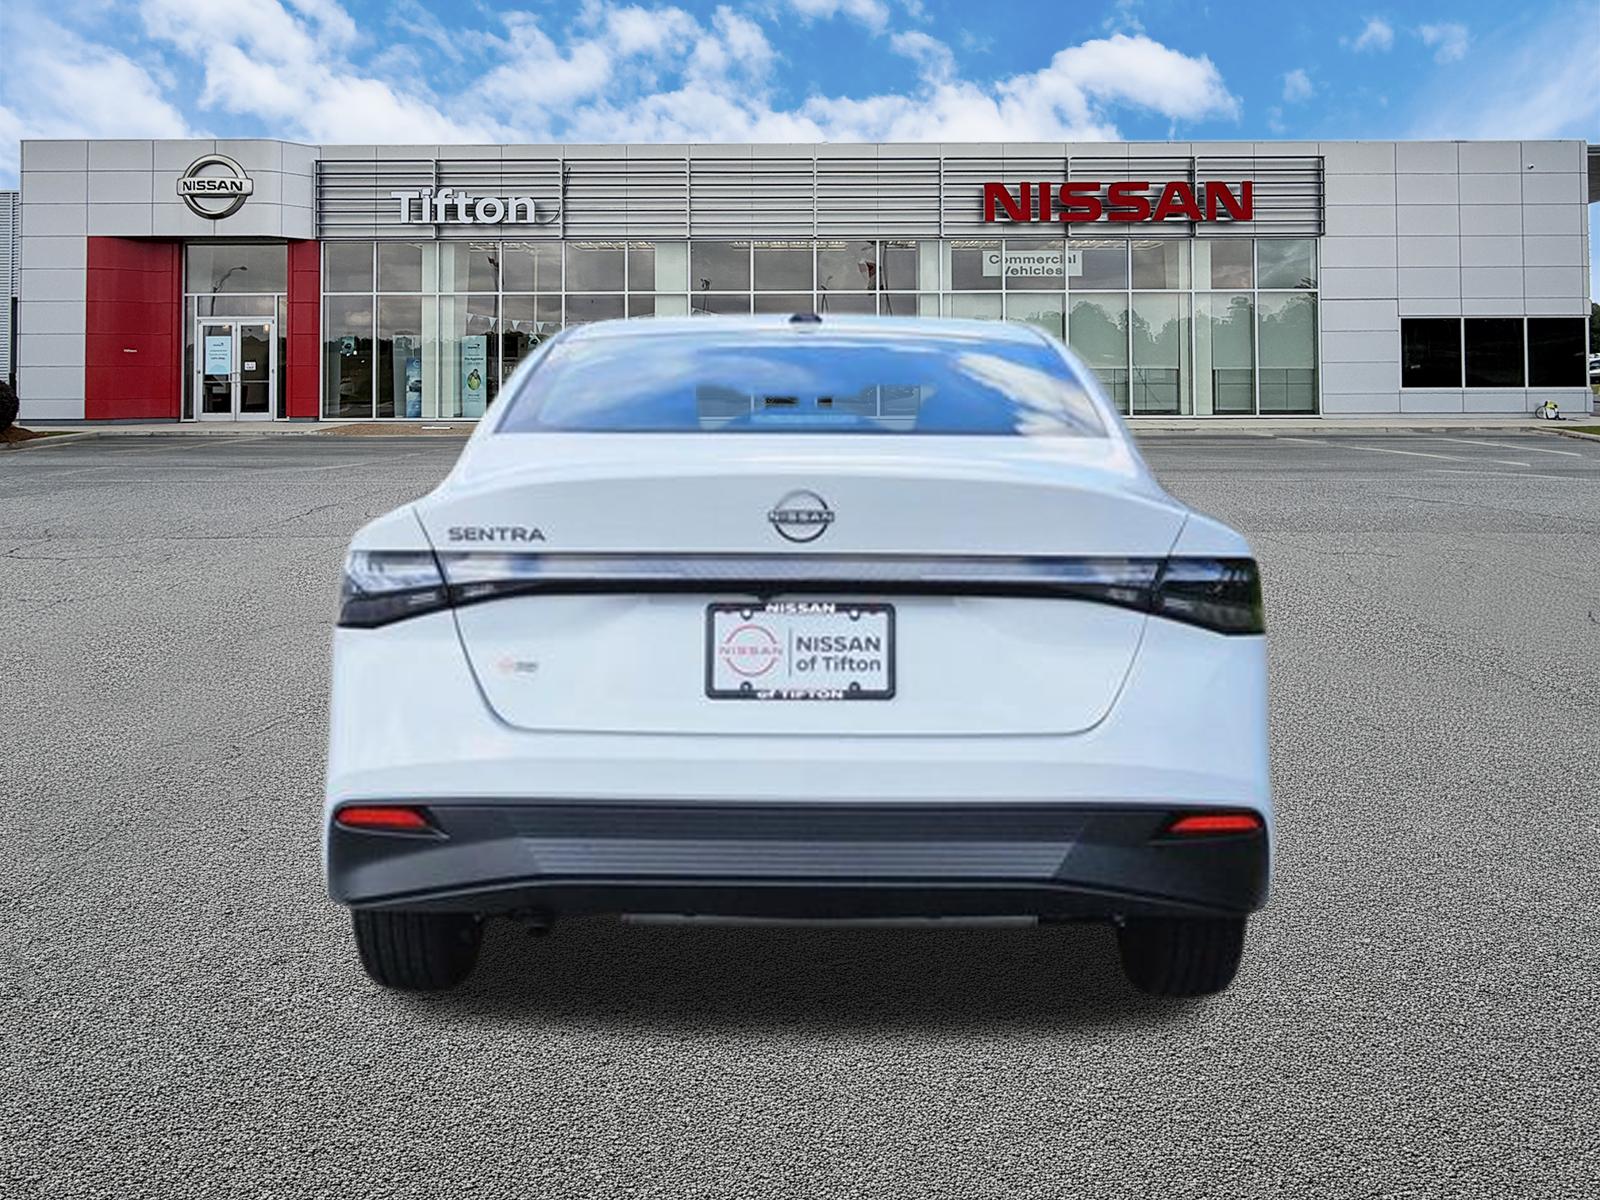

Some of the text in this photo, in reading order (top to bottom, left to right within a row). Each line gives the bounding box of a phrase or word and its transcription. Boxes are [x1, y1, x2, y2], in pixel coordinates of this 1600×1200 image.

[182, 180, 243, 192] NISSAN
[391, 188, 536, 224] Tifton
[984, 181, 1253, 222] NISSAN
[449, 526, 546, 542] SENTRA
[765, 602, 836, 613] NISSAN
[796, 636, 882, 652] NISSAN
[795, 655, 881, 672] of Tifton
[780, 689, 844, 700] TIFTON
